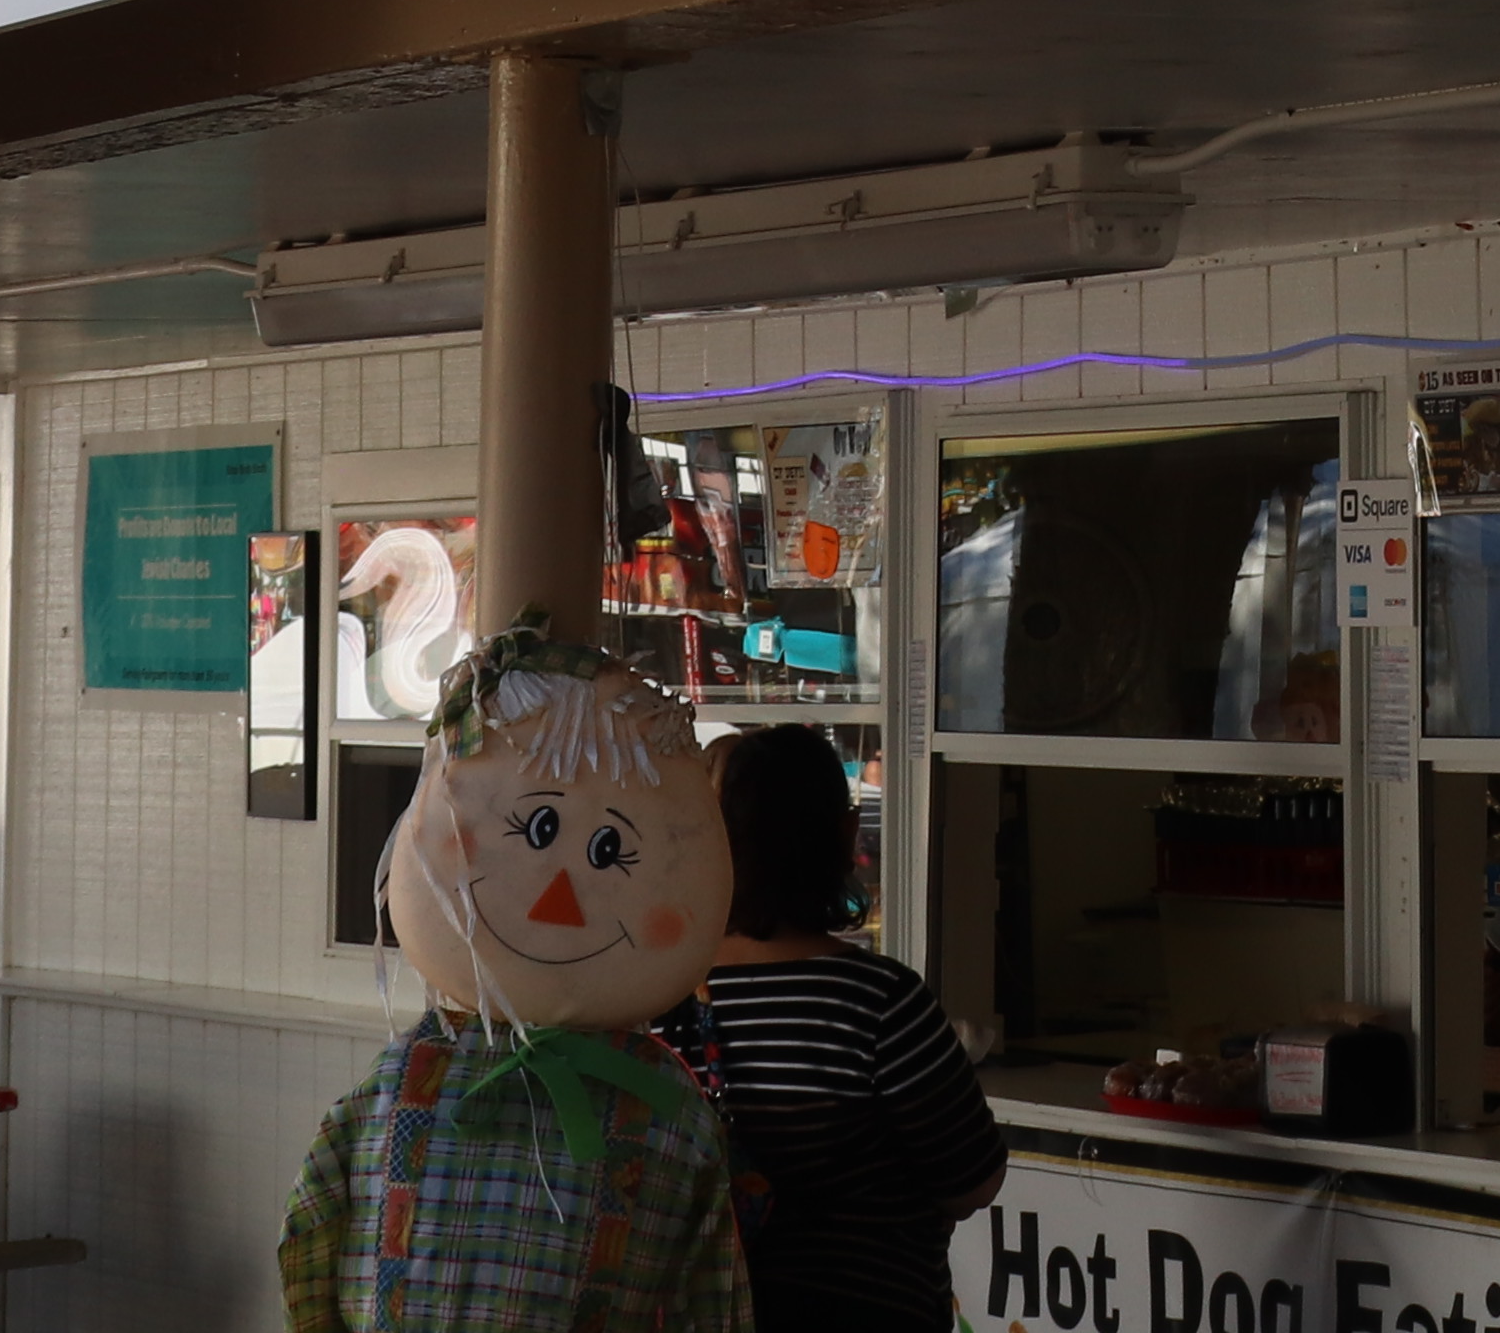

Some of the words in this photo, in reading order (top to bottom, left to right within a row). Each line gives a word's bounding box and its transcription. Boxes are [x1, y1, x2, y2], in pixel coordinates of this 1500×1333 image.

[1442, 372, 1455, 387] AS
[1456, 369, 1479, 386] SEEN
[1481, 369, 1494, 384] ON
[1362, 493, 1409, 523] Square
[1343, 544, 1373, 564] VISA
[988, 1205, 1119, 1330] Hot
